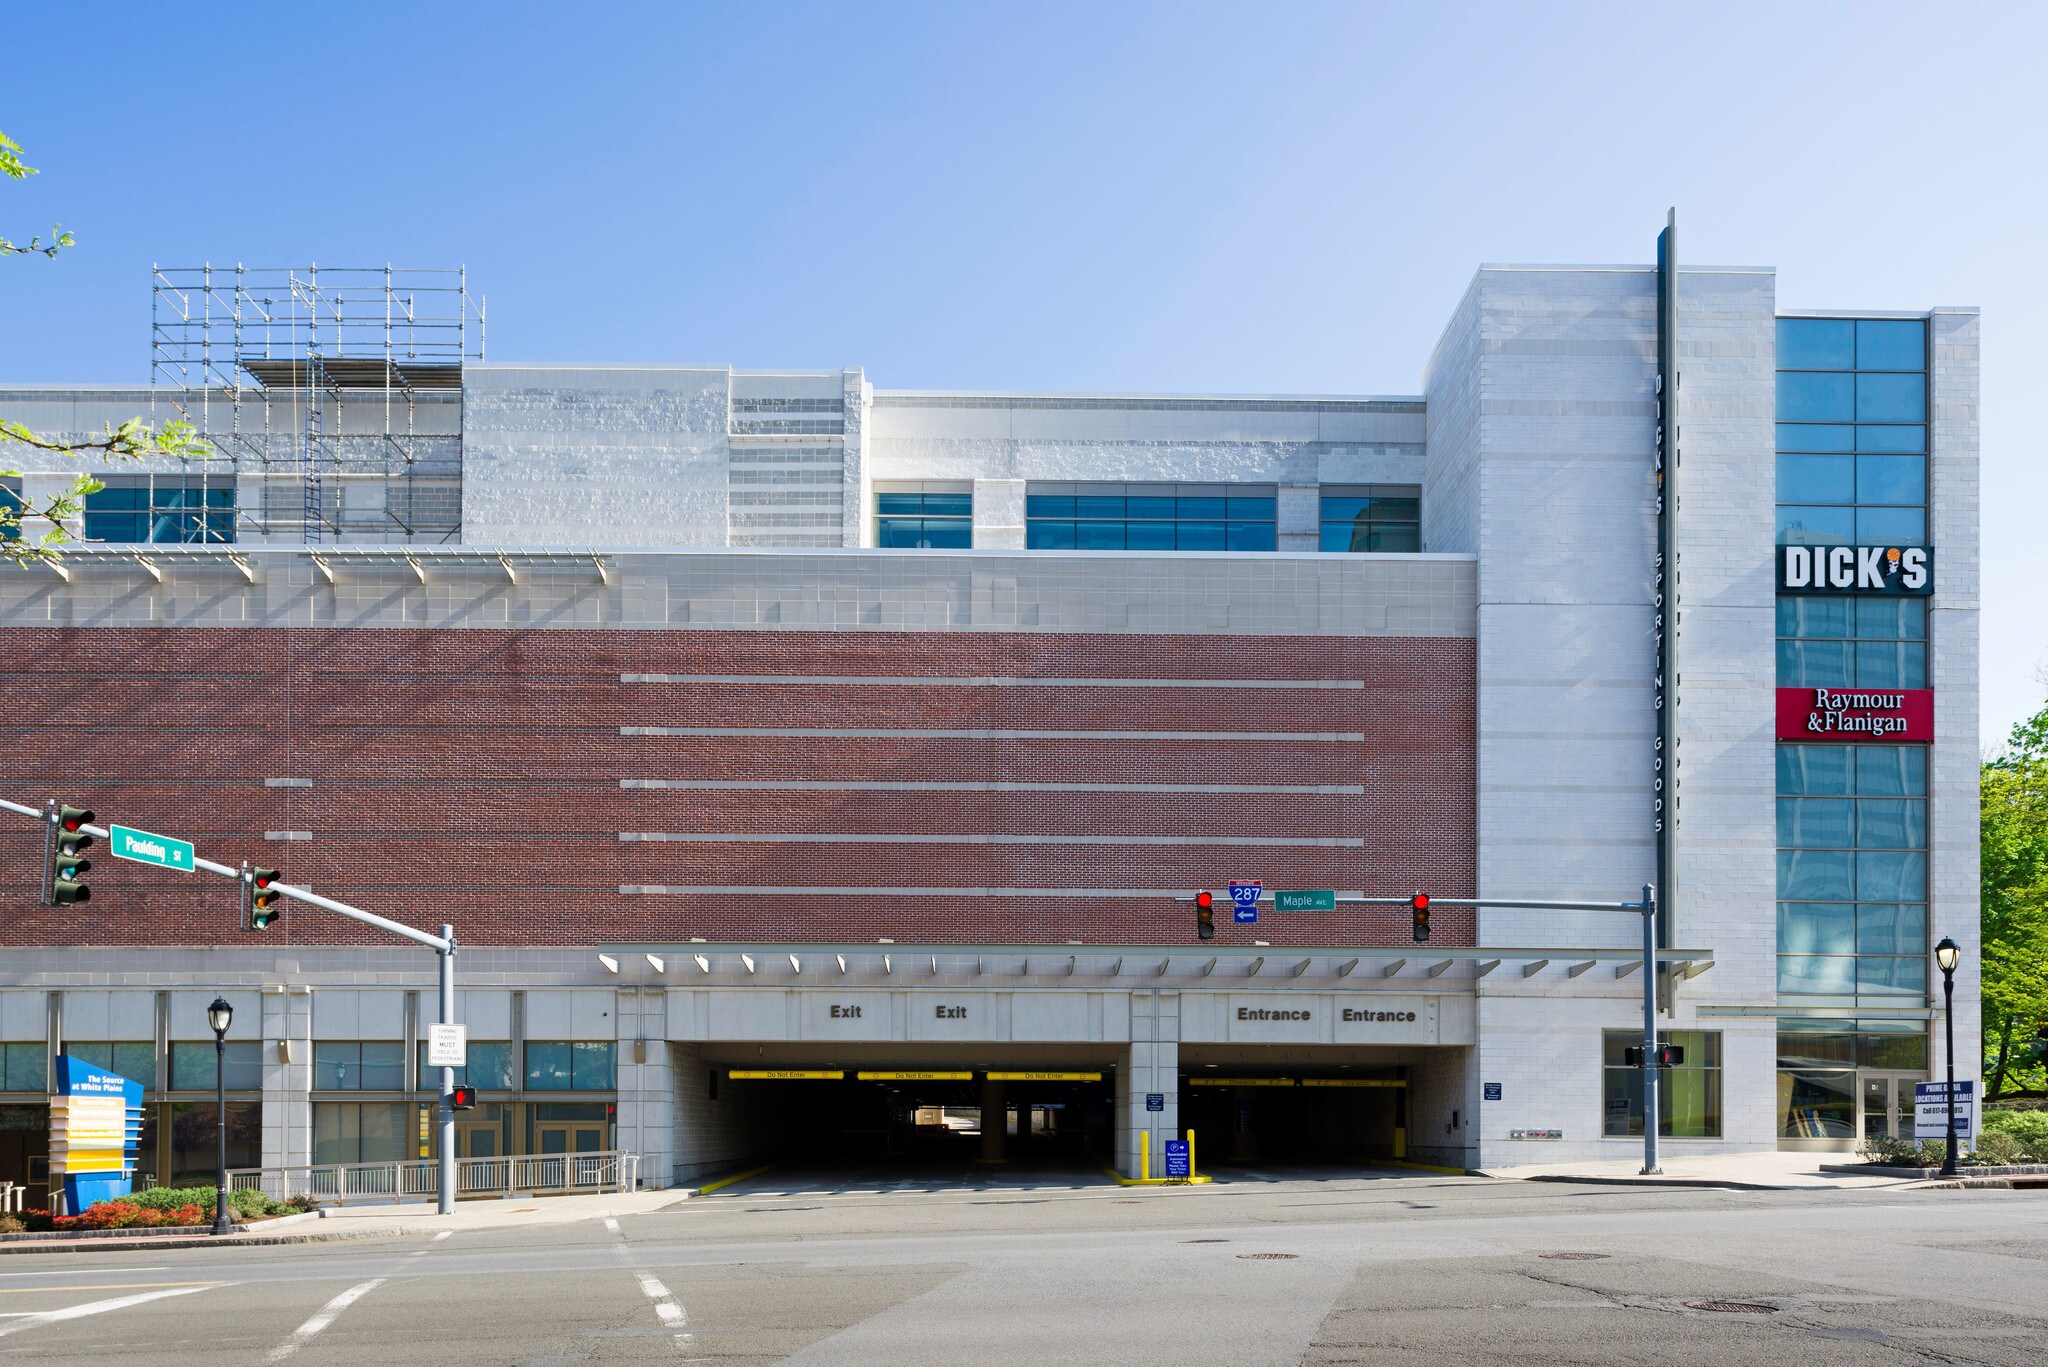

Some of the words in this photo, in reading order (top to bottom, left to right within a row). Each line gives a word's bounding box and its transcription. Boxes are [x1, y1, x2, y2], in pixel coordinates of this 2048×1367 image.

[1786, 546, 1927, 589] DICK'S
[1654, 553, 1662, 709] SPORTING
[1815, 688, 1905, 712] Raymour
[1654, 736, 1662, 832] GOODS
[125, 835, 166, 863] Paulding
[1234, 888, 1260, 900] 287
[1283, 896, 1313, 908] Maple
[830, 1005, 862, 1018] Exit
[936, 1006, 966, 1018] Exit
[1237, 1008, 1311, 1020] Entrance
[1342, 1008, 1416, 1022] Entrance
[88, 1075, 100, 1083] The
[102, 1076, 124, 1084] Source
[1915, 1094, 1943, 1103] LOCATIONS
